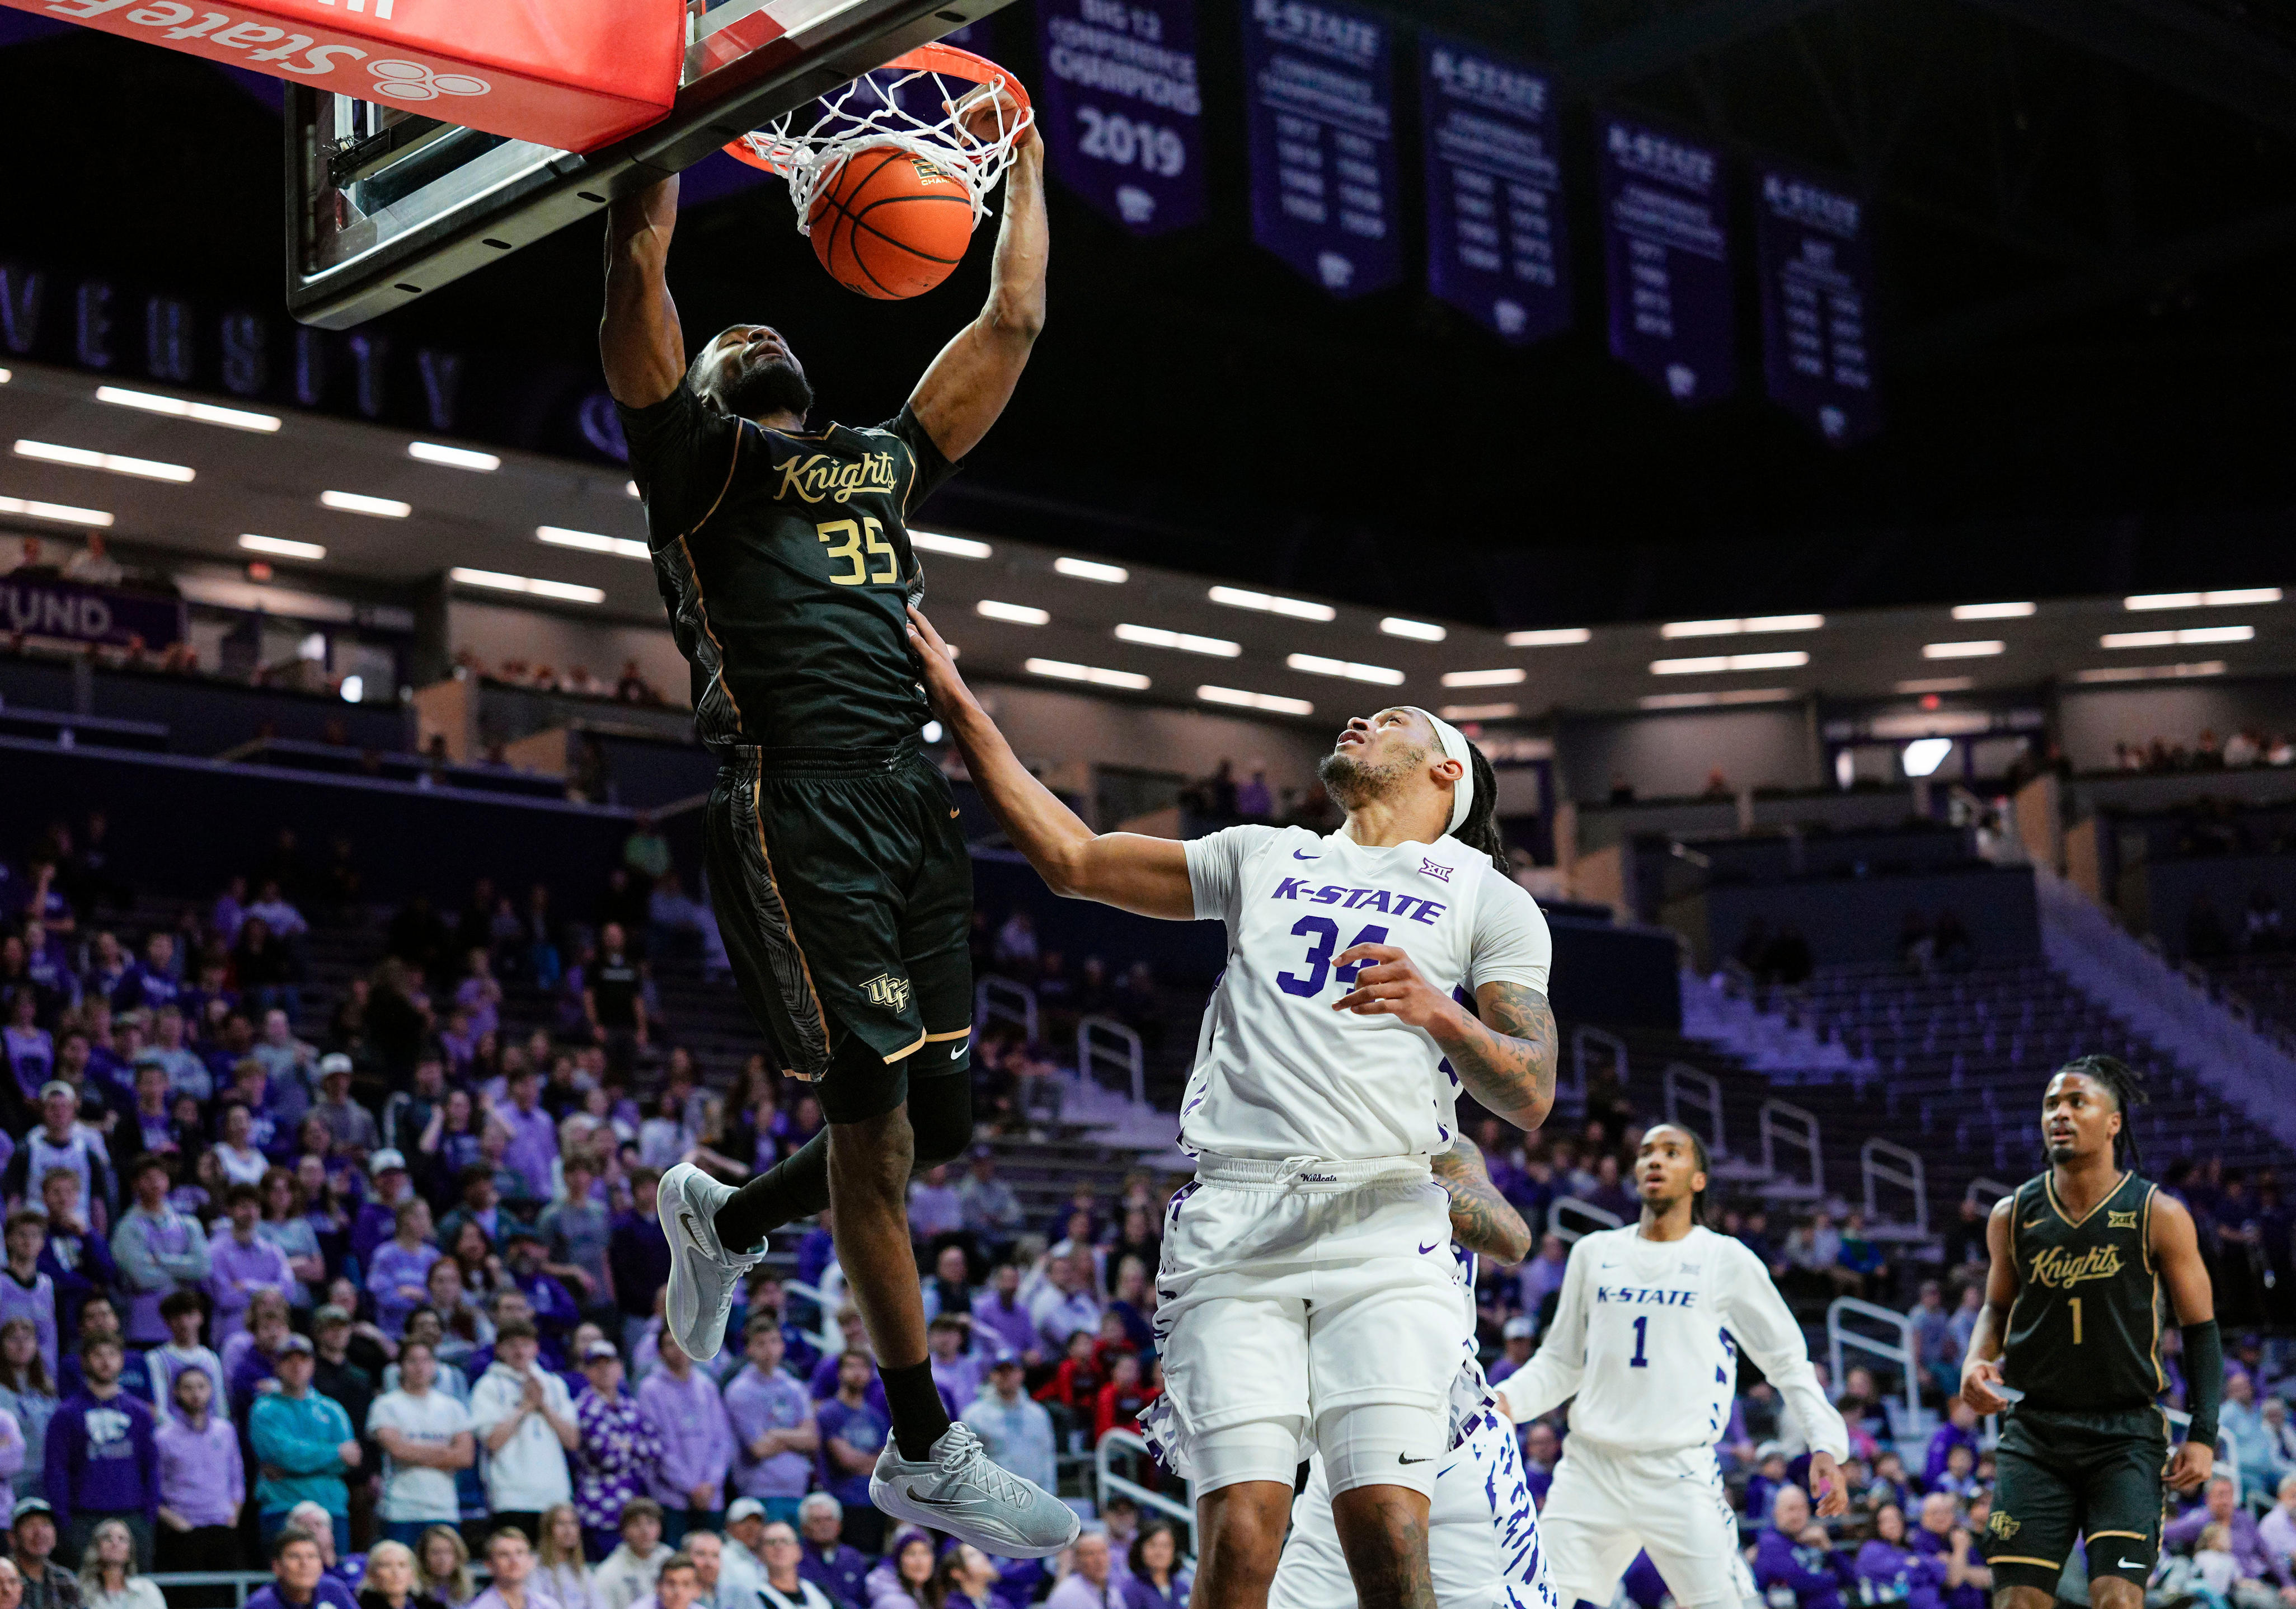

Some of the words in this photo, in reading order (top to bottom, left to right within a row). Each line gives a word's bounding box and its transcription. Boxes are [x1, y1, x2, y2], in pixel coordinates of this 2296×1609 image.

[126, 1, 369, 75] State
[1076, 106, 1186, 177] 2019
[773, 451, 897, 504] Knights
[816, 517, 898, 585] 35
[1270, 876, 1447, 926] K-STATE
[858, 973, 910, 1014] UCF
[1300, 1173, 1337, 1182] Wildcats
[2028, 1243, 2126, 1289] Knights
[1597, 1286, 1698, 1308] K-STATE
[2068, 1296, 2083, 1345] 1
[1629, 1315, 1649, 1368] 1
